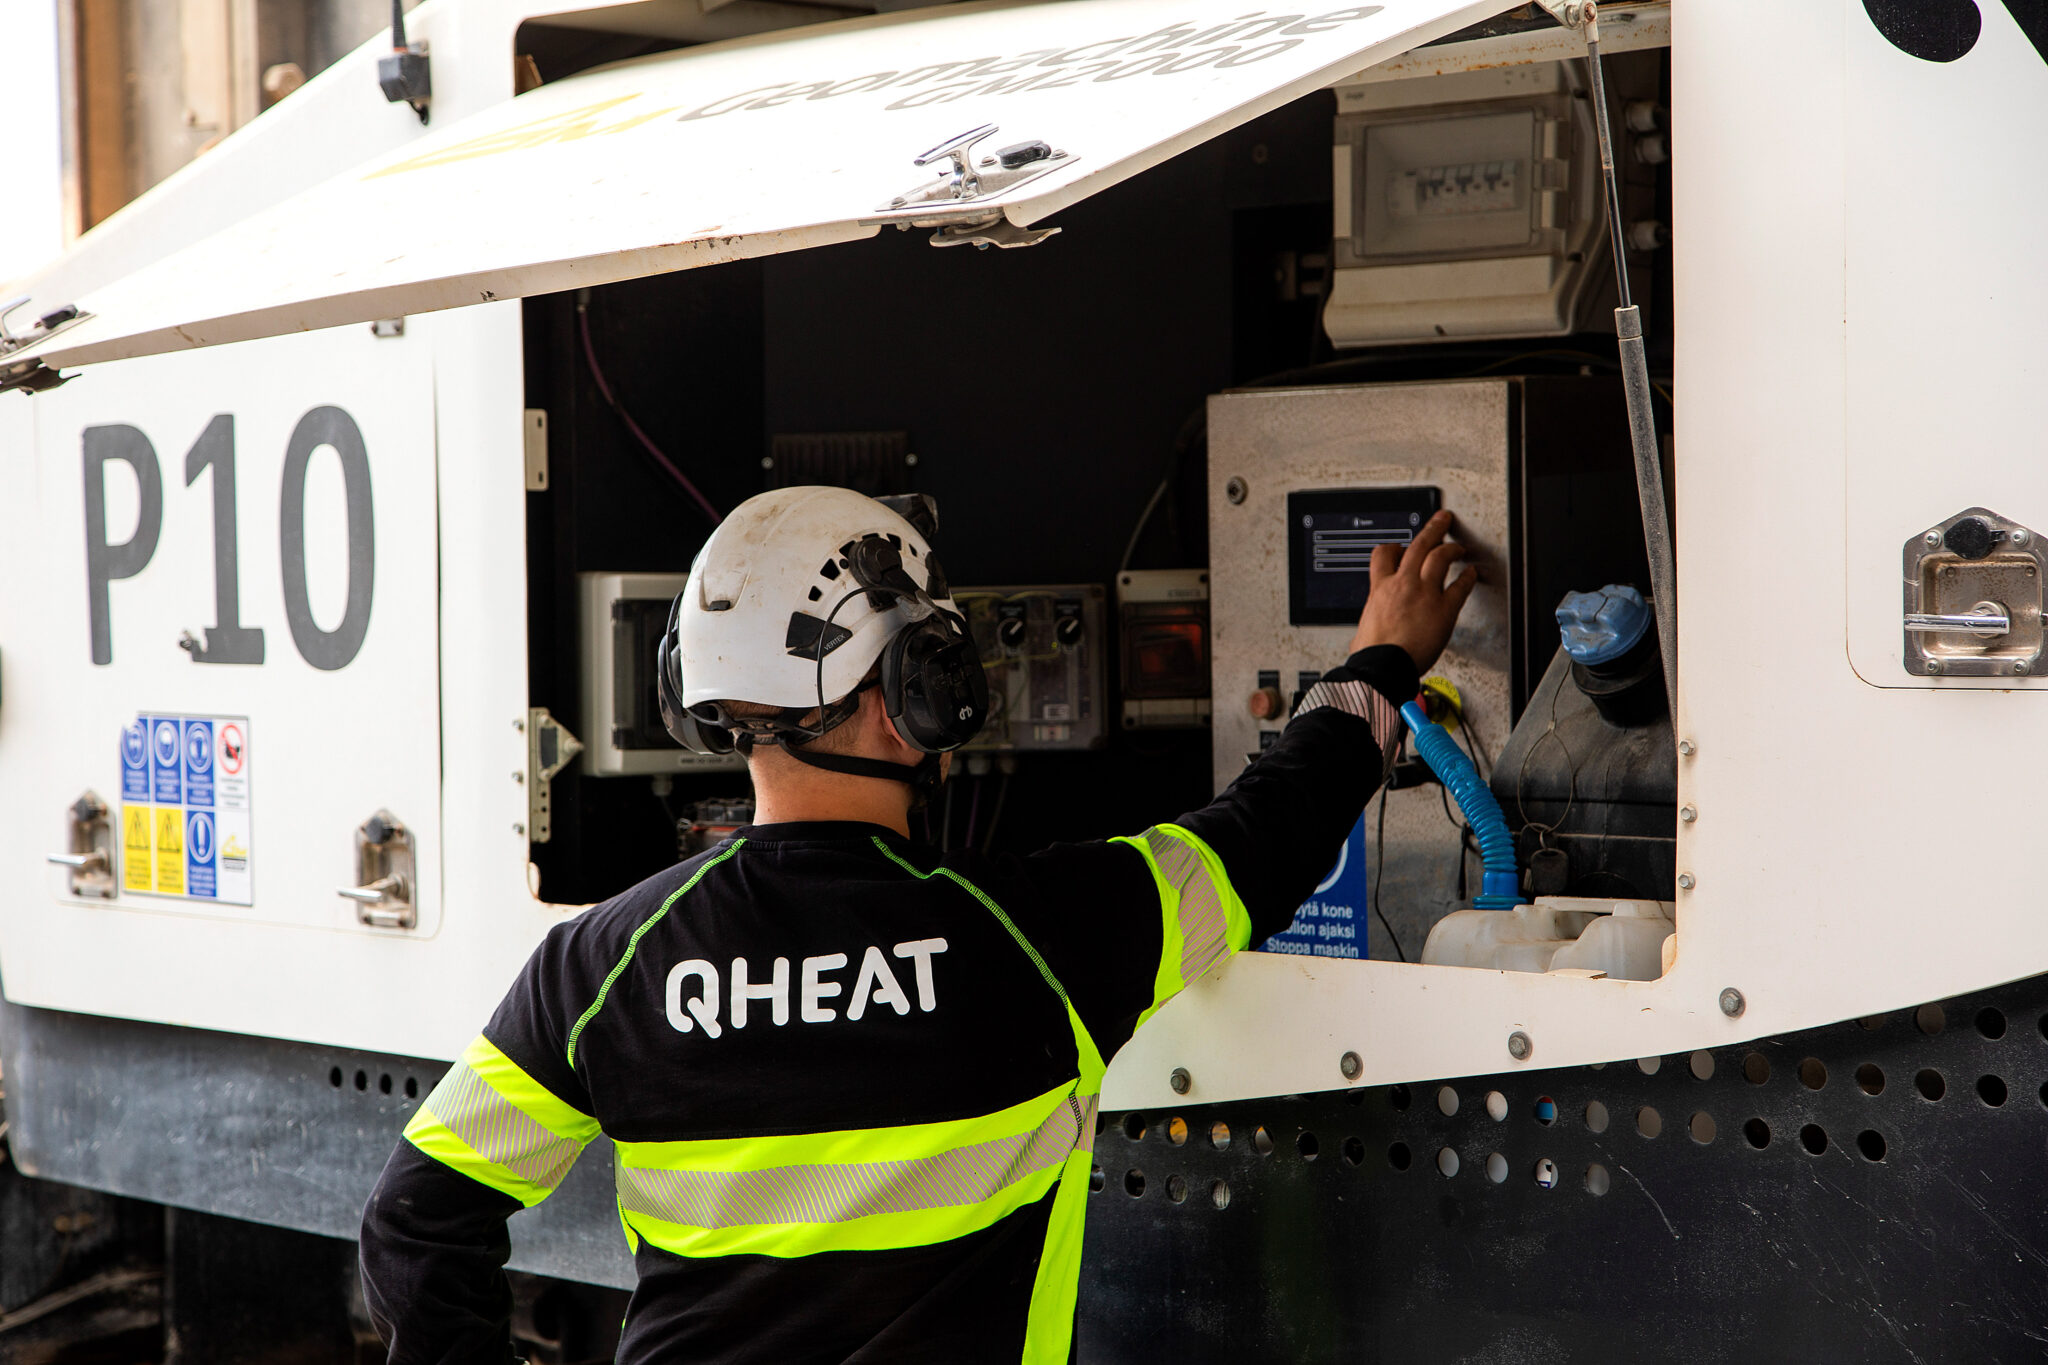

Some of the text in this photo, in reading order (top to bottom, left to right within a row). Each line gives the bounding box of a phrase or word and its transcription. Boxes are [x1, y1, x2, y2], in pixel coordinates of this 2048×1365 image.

[676, 5, 1385, 122] Geomachine
[81, 404, 375, 671] P10
[824, 633, 846, 651] VERTEX
[1321, 902, 1354, 919] kone
[1318, 922, 1356, 941] ajaksi
[1266, 937, 1359, 958] Stoppa maskin
[665, 937, 949, 1039] QHEAT
